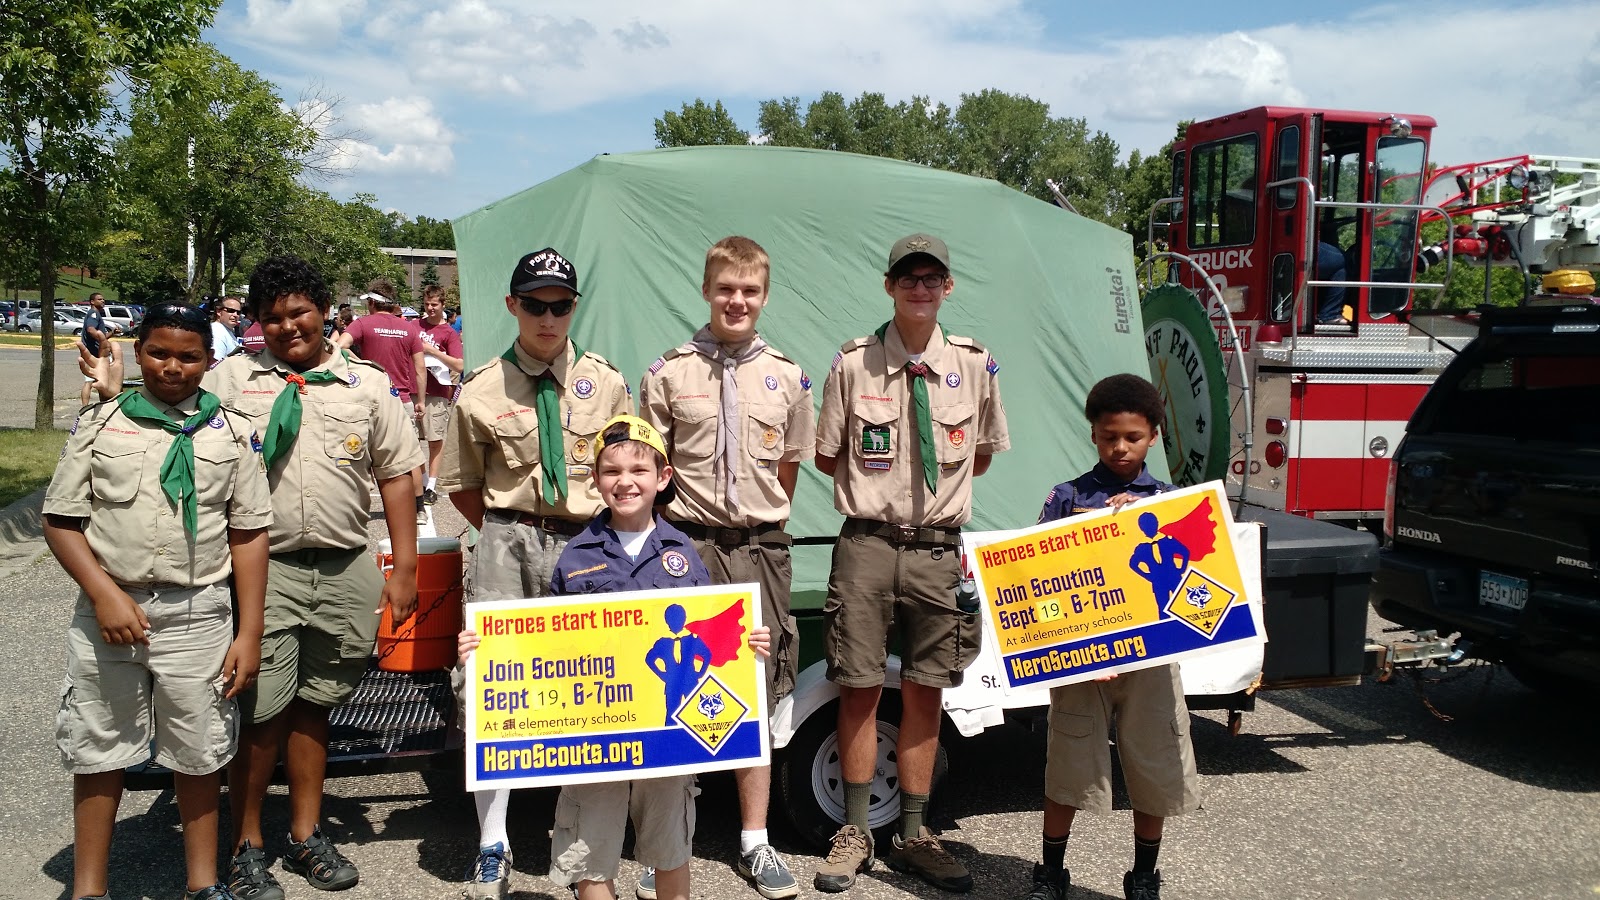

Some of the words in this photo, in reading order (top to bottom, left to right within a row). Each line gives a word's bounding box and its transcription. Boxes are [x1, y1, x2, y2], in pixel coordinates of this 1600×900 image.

[529, 252, 547, 267] POW
[556, 255, 570, 271] MIA
[1187, 249, 1253, 271] TRUCK
[1105, 266, 1131, 334] Eureka!
[1168, 327, 1204, 399] PAUL
[981, 543, 1036, 568] Heroes
[1039, 530, 1080, 555] start
[1082, 522, 1125, 544] here.
[1398, 526, 1442, 543] HONDA
[995, 583, 1028, 606] Join
[1030, 566, 1106, 598] Scouting
[483, 615, 546, 636] Heroes
[551, 611, 597, 632] start
[602, 608, 649, 628] here.
[998, 605, 1038, 630] Sept
[1070, 587, 1126, 614] 6-7pm
[1006, 637, 1017, 647] At
[1020, 632, 1032, 644] all
[1033, 622, 1090, 643] elementary
[1092, 611, 1133, 628] schools
[483, 659, 525, 682] Join
[532, 654, 615, 679] Scouting
[1011, 635, 1146, 679] HeroScouts.org
[484, 688, 529, 714] Sept
[573, 681, 633, 708] 6-7pm
[981, 675, 1001, 688] St.
[483, 720, 499, 731] At
[519, 716, 588, 730] elementary
[591, 710, 637, 725] schools
[483, 739, 644, 772] HeroScouts.org
